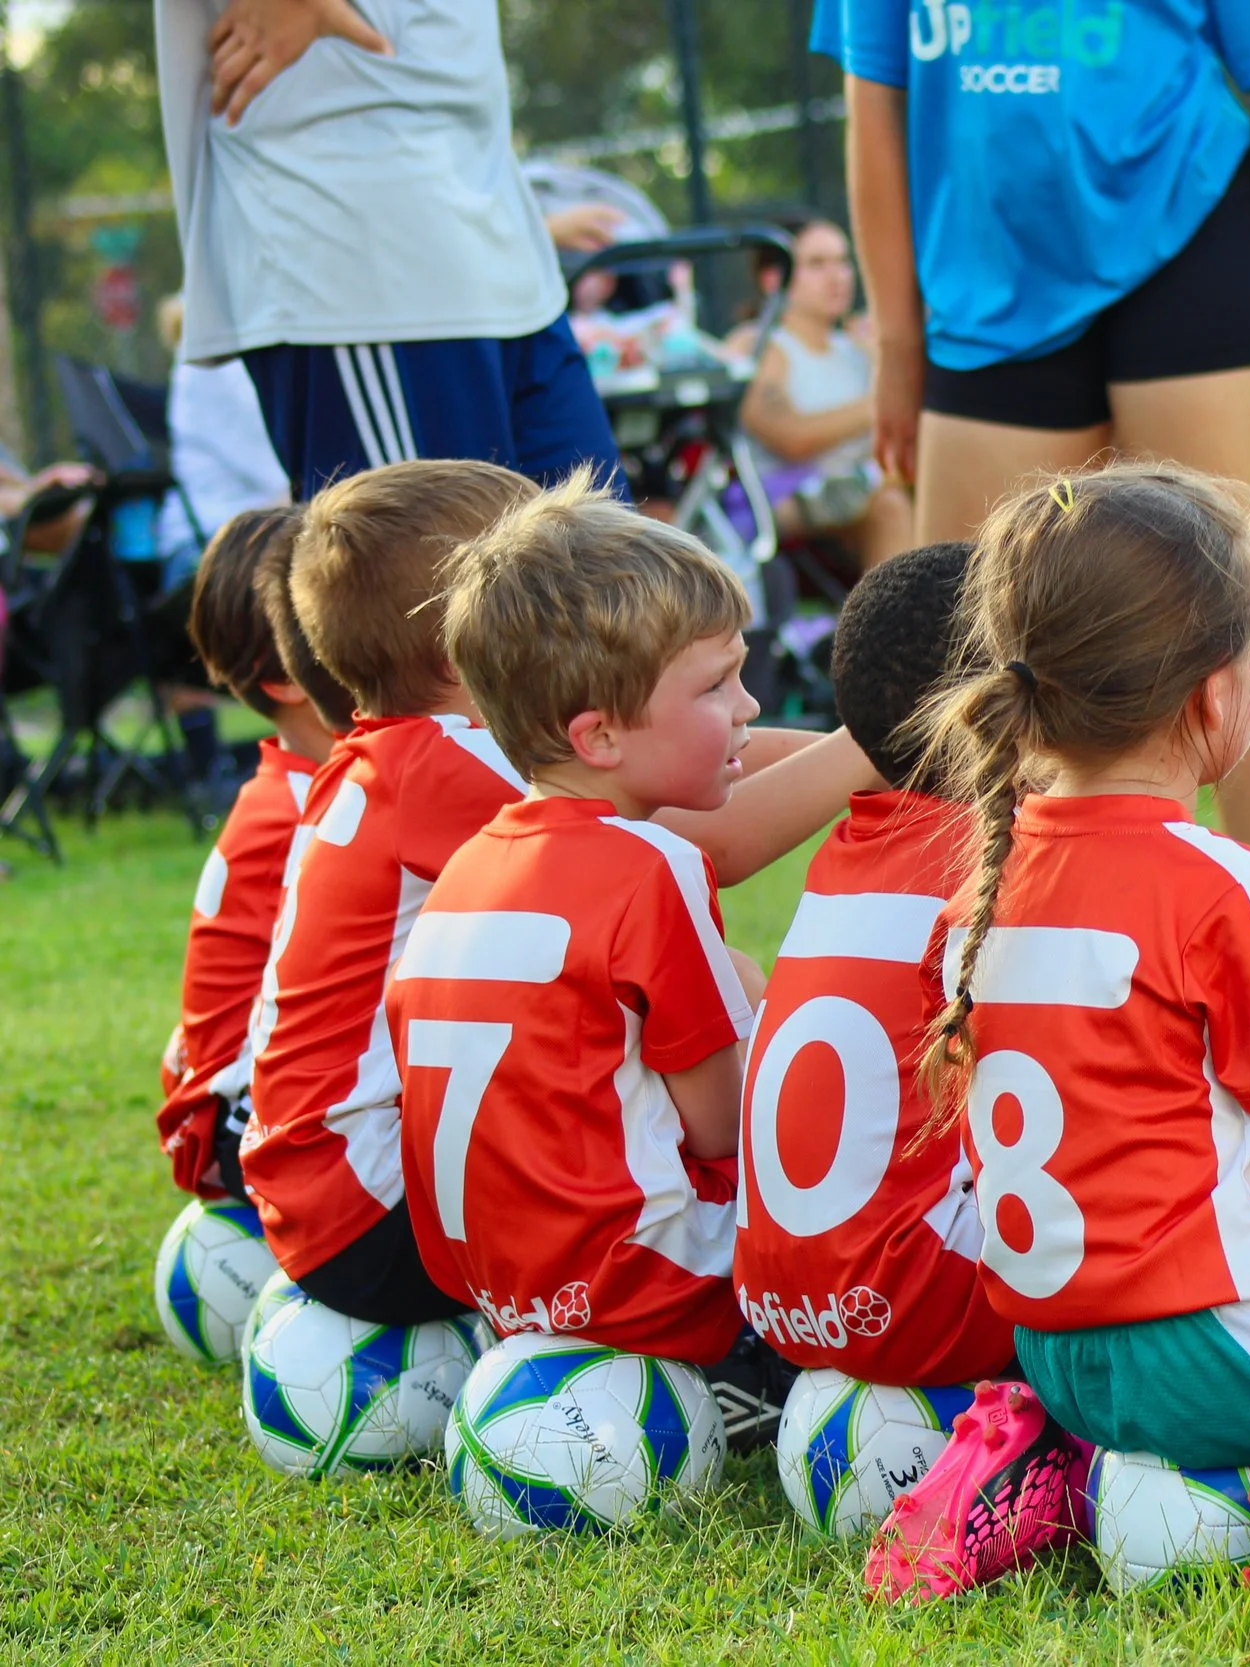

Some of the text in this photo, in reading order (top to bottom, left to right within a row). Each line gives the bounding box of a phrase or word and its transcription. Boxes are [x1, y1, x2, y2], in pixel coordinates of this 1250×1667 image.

[960, 64, 1061, 93] SOCCER
[407, 1019, 513, 1243] 7
[967, 1050, 1085, 1299] 8
[562, 1406, 618, 1464] Aoneky
[889, 1465, 918, 1488] 3
